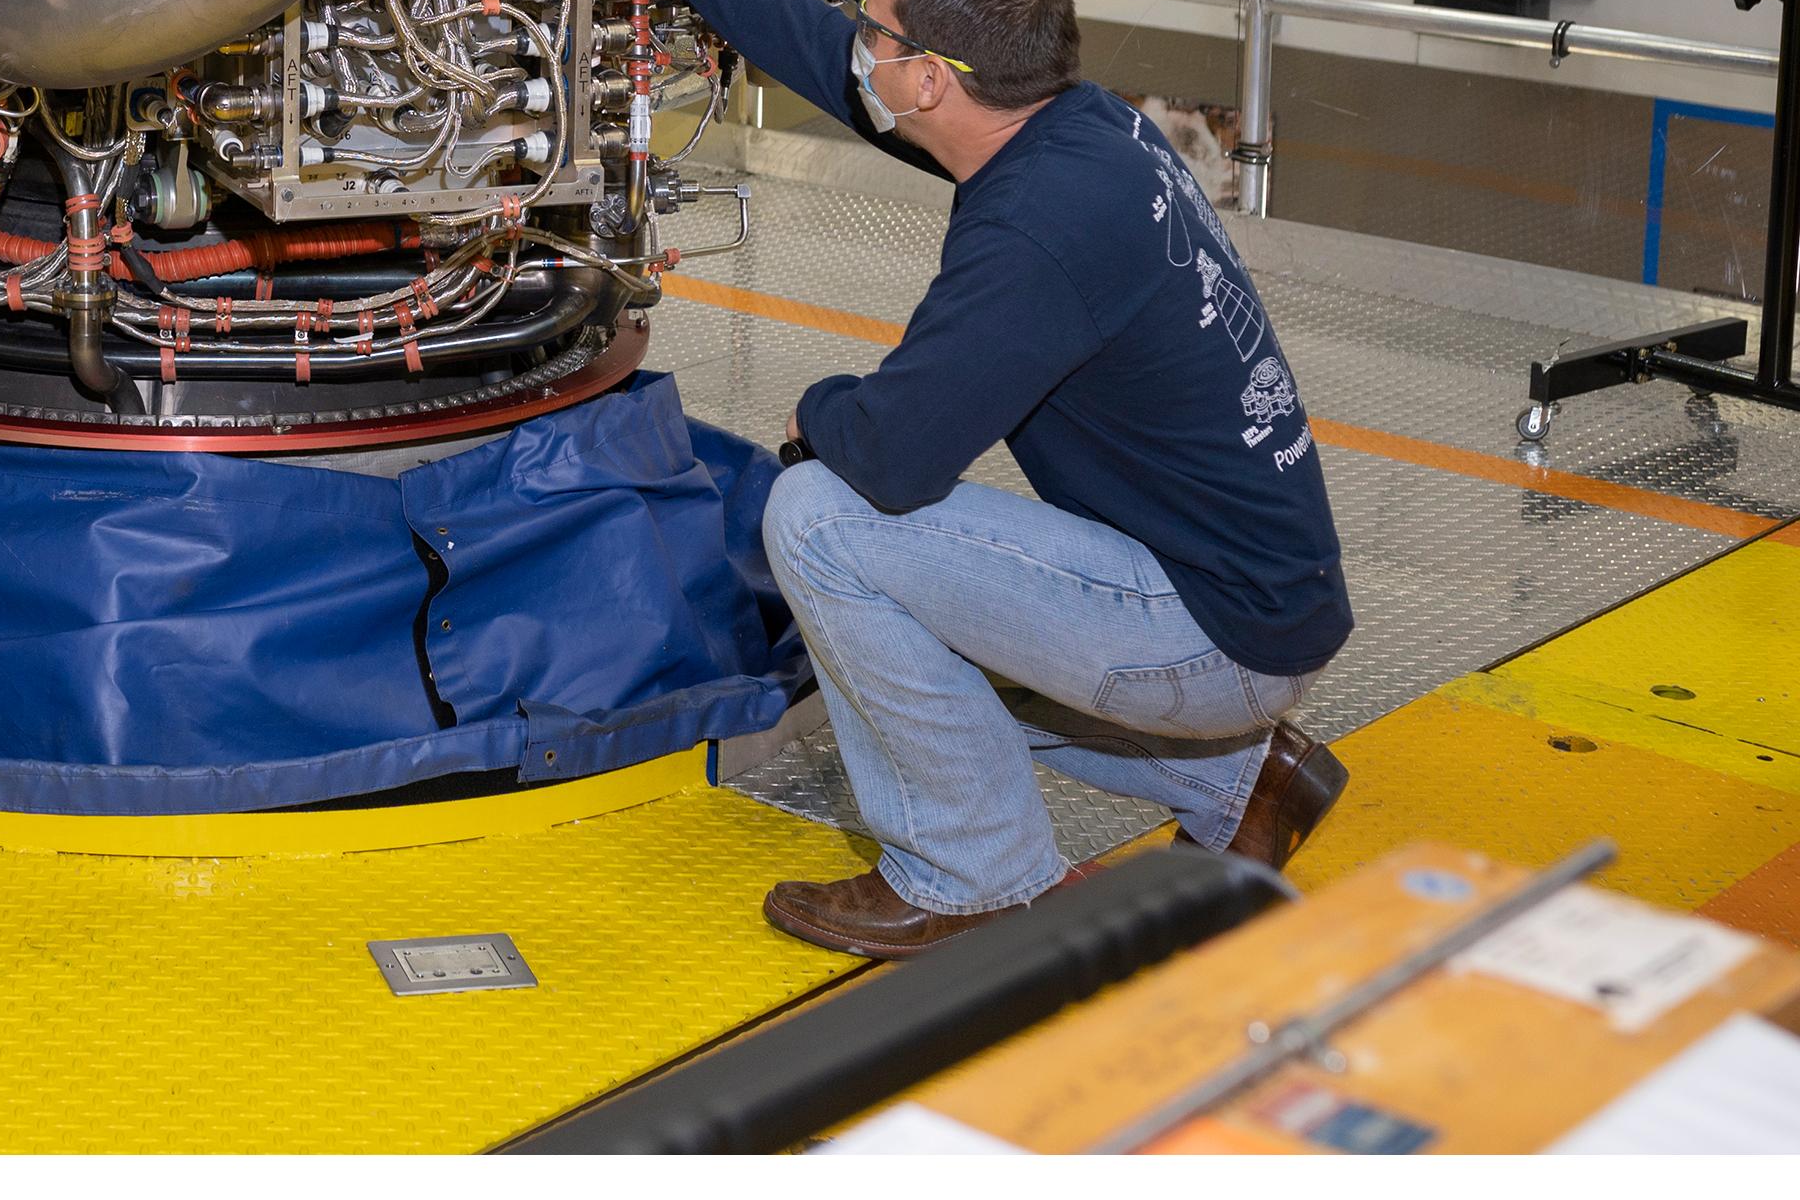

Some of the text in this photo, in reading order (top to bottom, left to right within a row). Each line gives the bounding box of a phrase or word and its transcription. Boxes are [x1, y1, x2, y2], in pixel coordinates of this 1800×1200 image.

[287, 58, 298, 101] AFT
[578, 52, 589, 93] AFT
[342, 180, 356, 191] J2
[575, 188, 589, 196] AFT
[1241, 425, 1259, 443] AEPS
[1245, 424, 1274, 449] Thrusters
